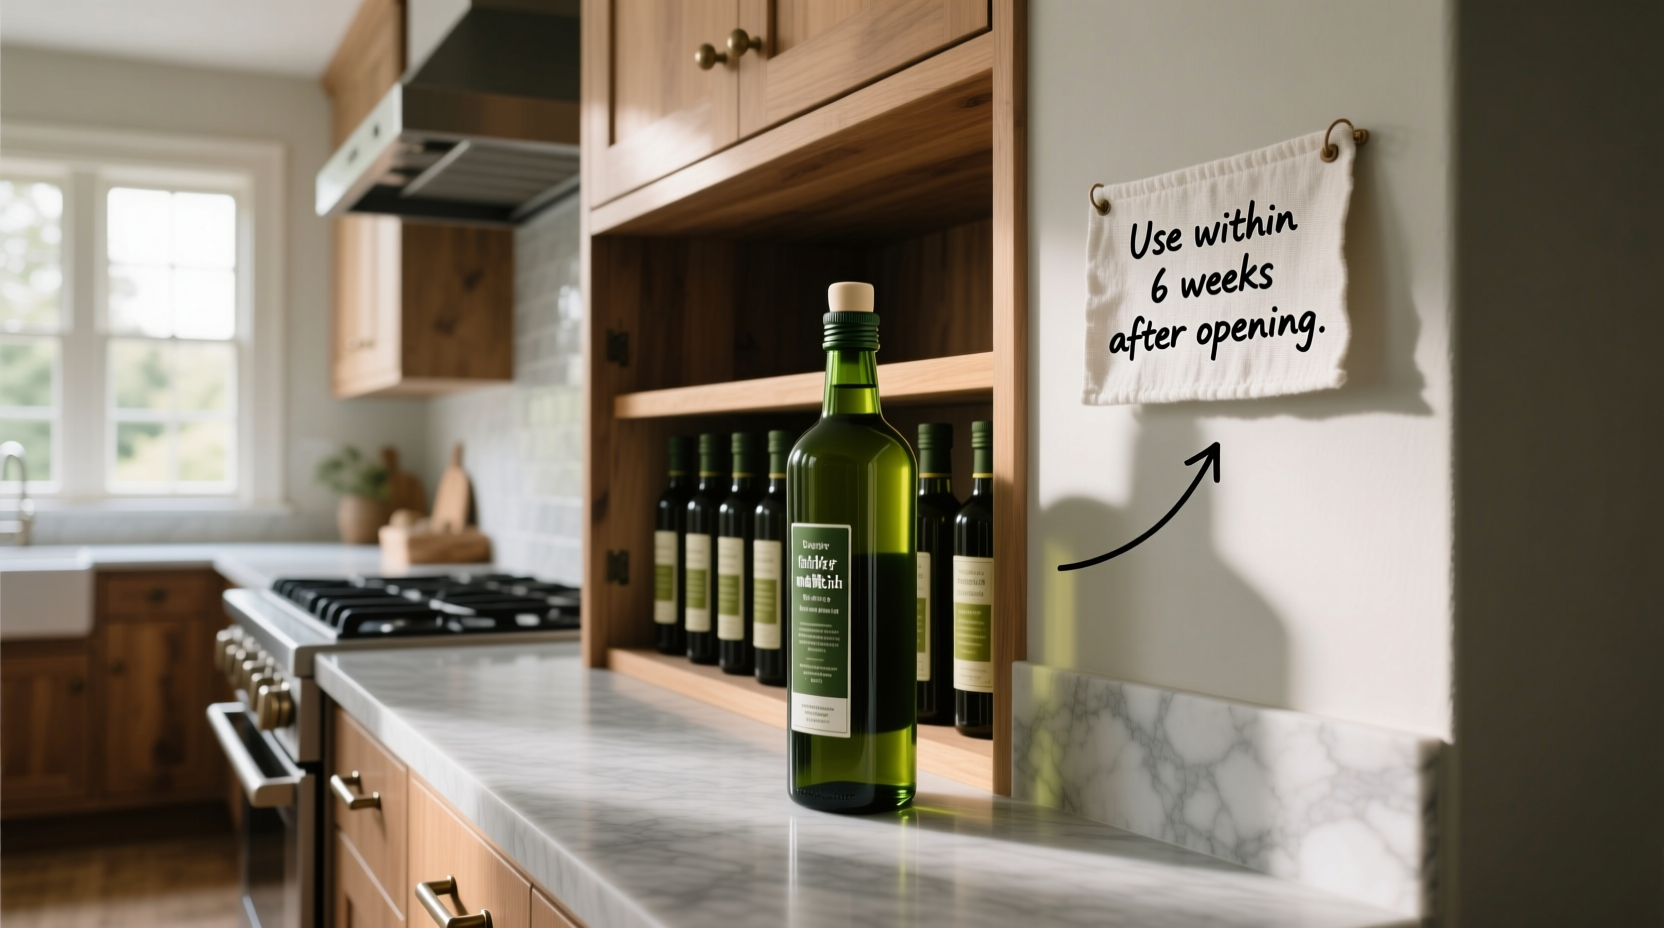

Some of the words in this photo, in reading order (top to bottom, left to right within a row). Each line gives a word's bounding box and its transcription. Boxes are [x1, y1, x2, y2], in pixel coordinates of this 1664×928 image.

[1130, 220, 1182, 259] Use
[1194, 200, 1298, 247] within
[1151, 267, 1168, 303] 6
[1181, 252, 1273, 298] weeks
[1109, 315, 1187, 361] after
[1196, 306, 1325, 361] opening.
